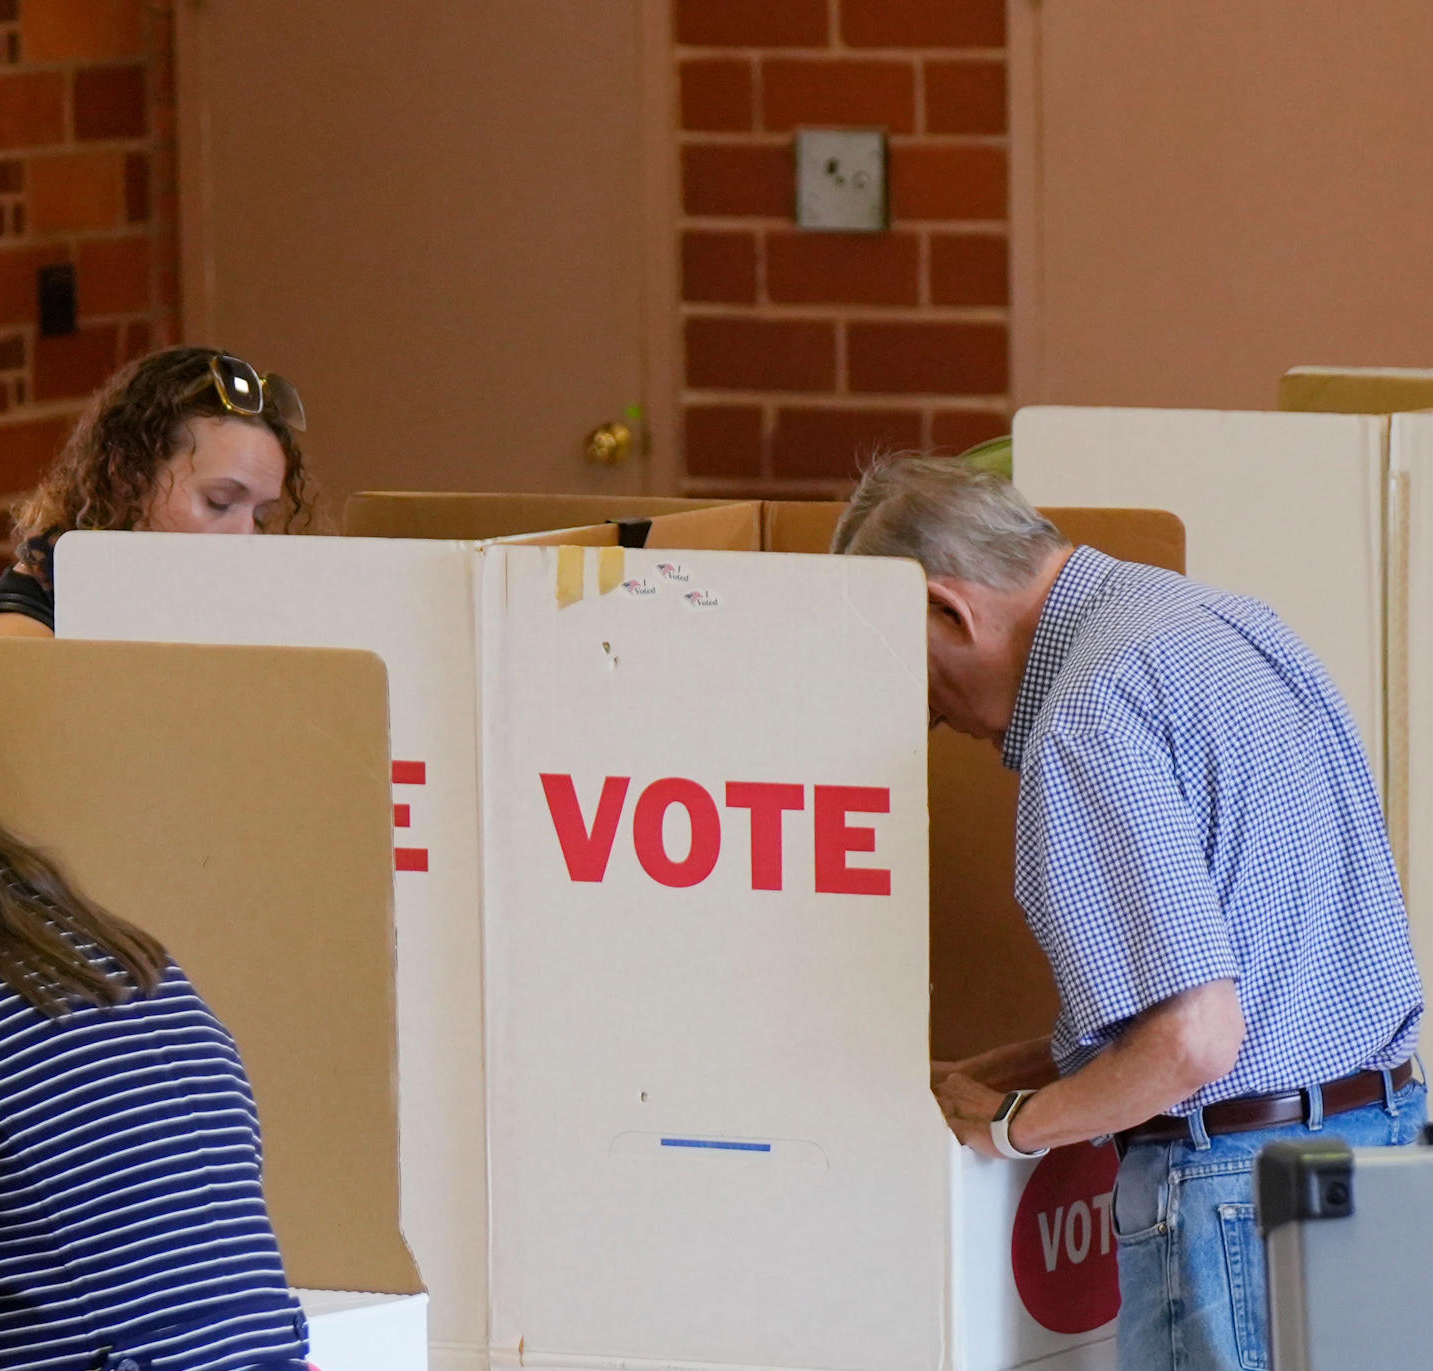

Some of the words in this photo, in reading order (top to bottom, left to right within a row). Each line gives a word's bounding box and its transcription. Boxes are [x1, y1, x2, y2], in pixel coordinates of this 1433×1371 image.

[668, 571, 689, 582] Voted
[634, 587, 656, 595] Voted
[697, 599, 719, 607] Voted
[540, 773, 892, 897] VOTE
[1037, 1191, 1114, 1273] VOT
